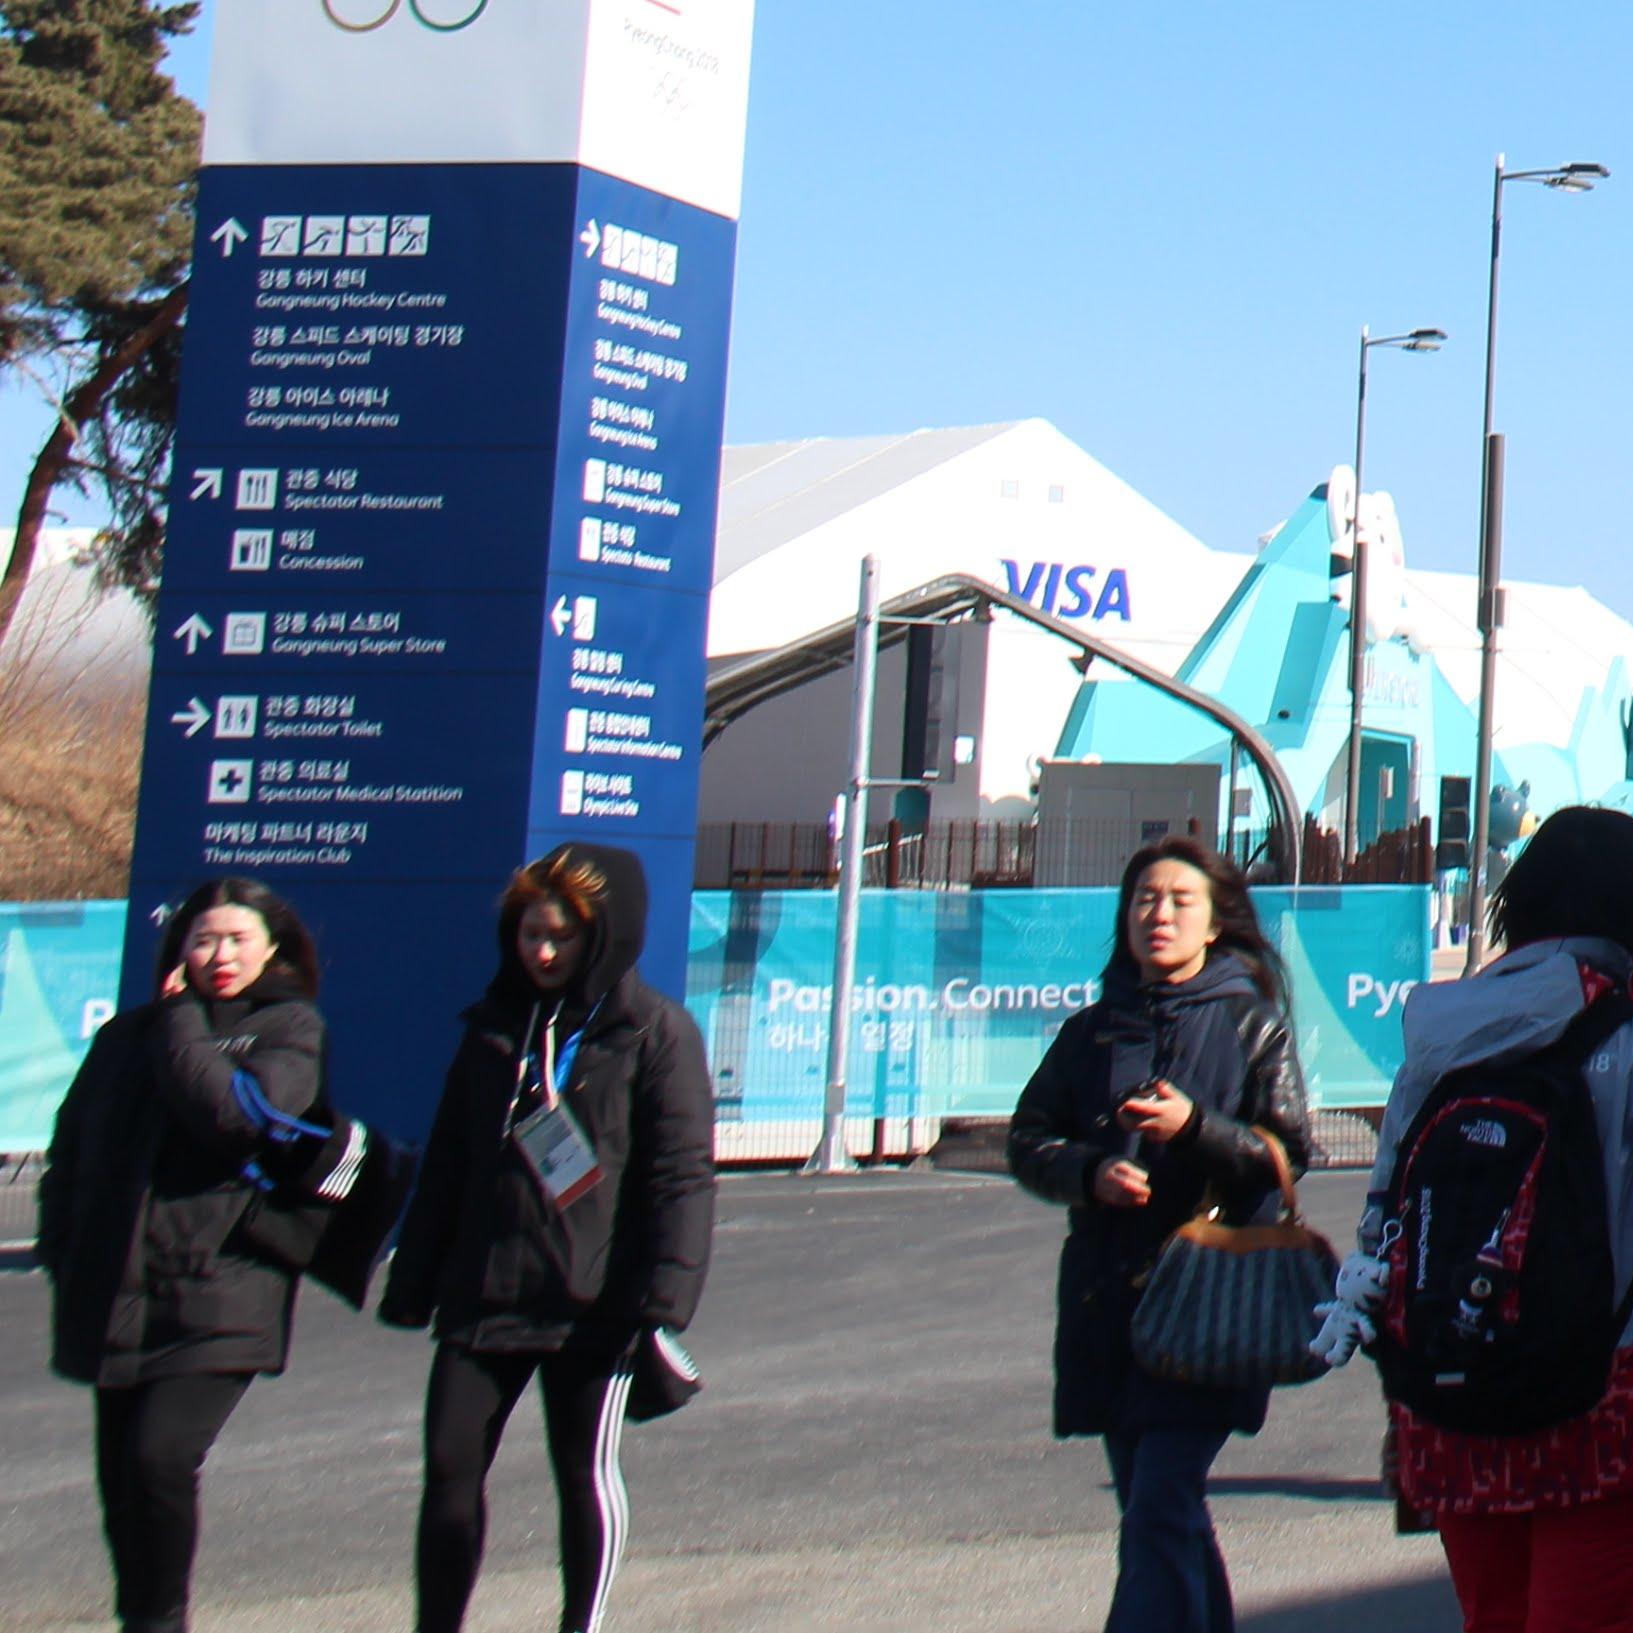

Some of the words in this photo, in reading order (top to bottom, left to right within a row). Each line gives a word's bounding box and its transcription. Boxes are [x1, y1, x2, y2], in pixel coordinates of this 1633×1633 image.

[258, 268, 290, 289] 강릉
[296, 268, 328, 289] 하키
[333, 268, 367, 289] 센터
[256, 292, 341, 311] Gangneung
[342, 292, 397, 311] Hockey
[397, 291, 447, 307] Centre
[252, 325, 287, 346] 강릉
[289, 325, 340, 346] 스피드
[344, 325, 410, 346] 스케이팅
[414, 325, 464, 346] 경기장
[250, 350, 335, 369] Gangneung
[336, 349, 371, 365] Oval
[248, 386, 282, 407] 강릉
[285, 386, 334, 407] 아이스
[339, 386, 391, 407] 아레나
[245, 412, 332, 430] Gangneung
[332, 412, 353, 428] Ice
[355, 412, 399, 428] Arena
[285, 468, 320, 490] 관중
[324, 468, 359, 490] 식당
[284, 494, 358, 511] Spectator
[359, 494, 444, 510] Restaurant
[281, 529, 315, 550] 매점
[279, 554, 365, 570] Concession
[1000, 558, 1131, 622] VISA
[274, 612, 308, 634] 강릉
[311, 612, 346, 634] 슈퍼
[350, 612, 401, 634] 스토어
[272, 637, 358, 656] Gangneung
[359, 637, 403, 655] Super
[405, 637, 446, 653] Store
[265, 695, 299, 717] 관중
[303, 695, 356, 717] 화장실
[264, 721, 338, 739] Spectator
[341, 721, 383, 737] Toilet
[259, 760, 295, 782] 관중
[297, 760, 350, 782] 의료실
[257, 786, 333, 804] Spectator
[336, 785, 393, 802] Medical
[205, 822, 257, 844] 마케팅
[261, 822, 312, 844] 파트너
[316, 822, 368, 844] 라운지
[204, 848, 233, 863] The
[234, 848, 314, 866] Inspiration
[316, 847, 351, 863] Club
